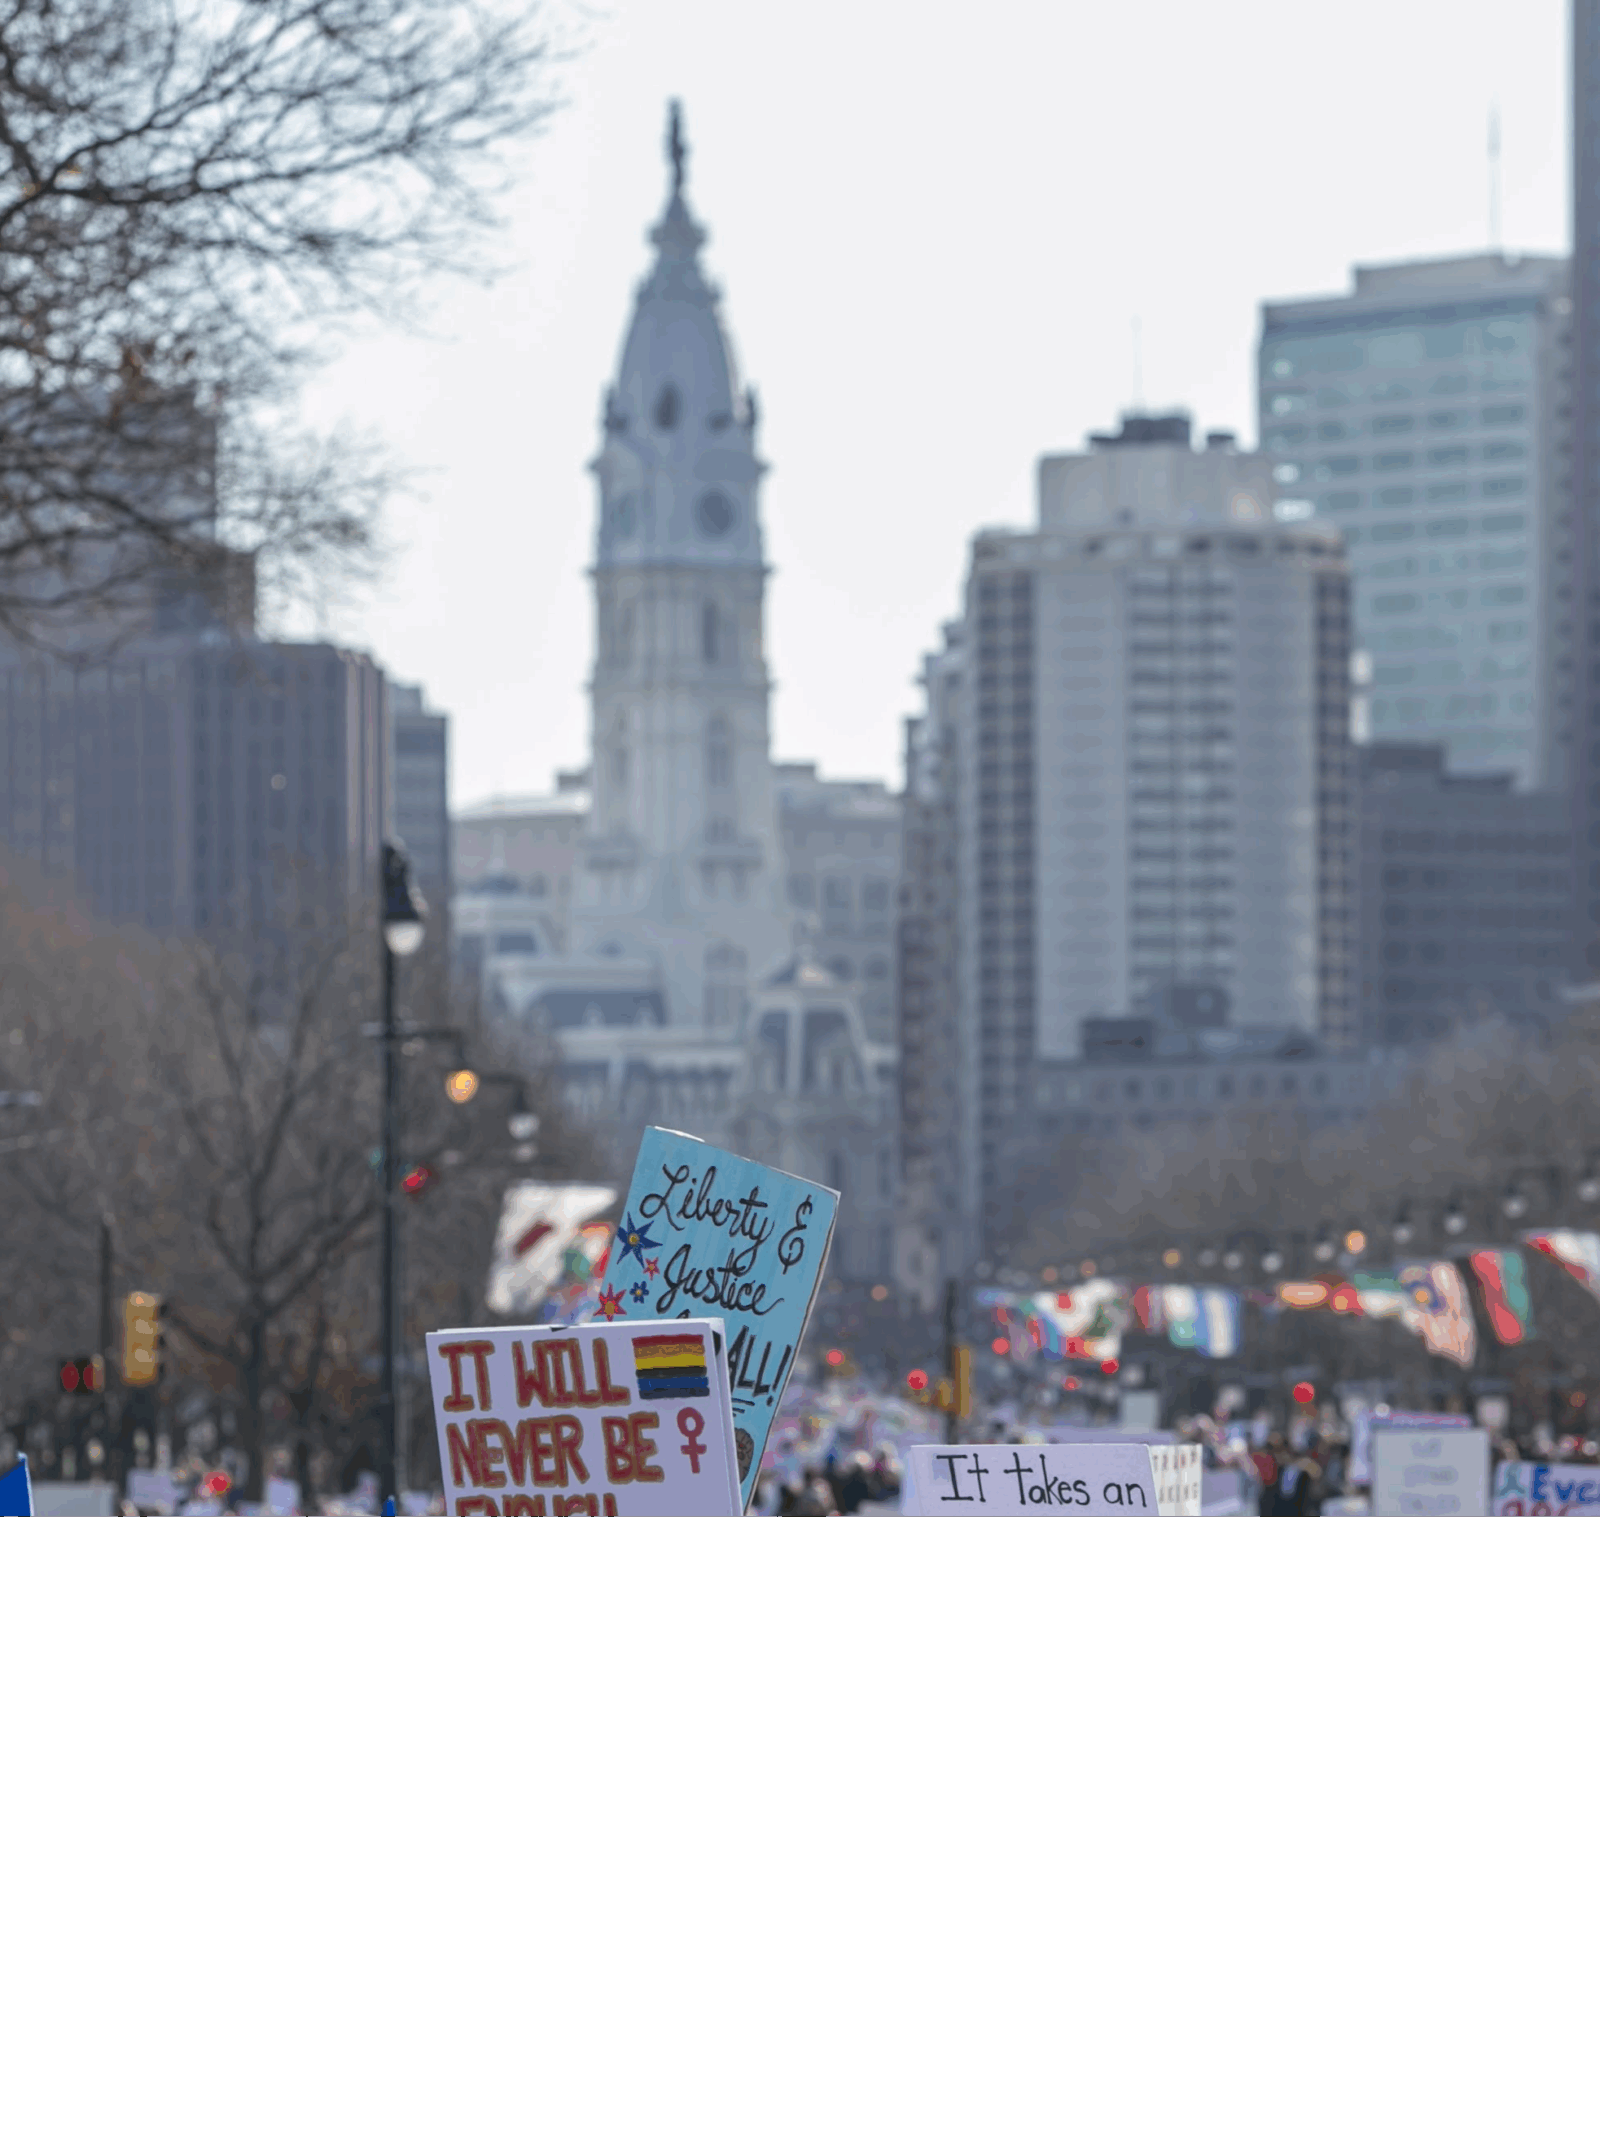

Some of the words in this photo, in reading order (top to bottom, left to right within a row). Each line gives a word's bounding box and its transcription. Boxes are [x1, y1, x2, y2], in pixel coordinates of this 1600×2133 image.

[639, 1163, 775, 1277] Liberty
[778, 1194, 812, 1275] &
[656, 1243, 785, 1315] Justice
[438, 1339, 495, 1412] IT
[511, 1337, 631, 1408] WILL
[446, 1414, 590, 1488] NEVER
[601, 1411, 665, 1485] BE
[936, 1453, 989, 1502] It
[1003, 1452, 1091, 1505] takes
[1103, 1481, 1148, 1507] an
